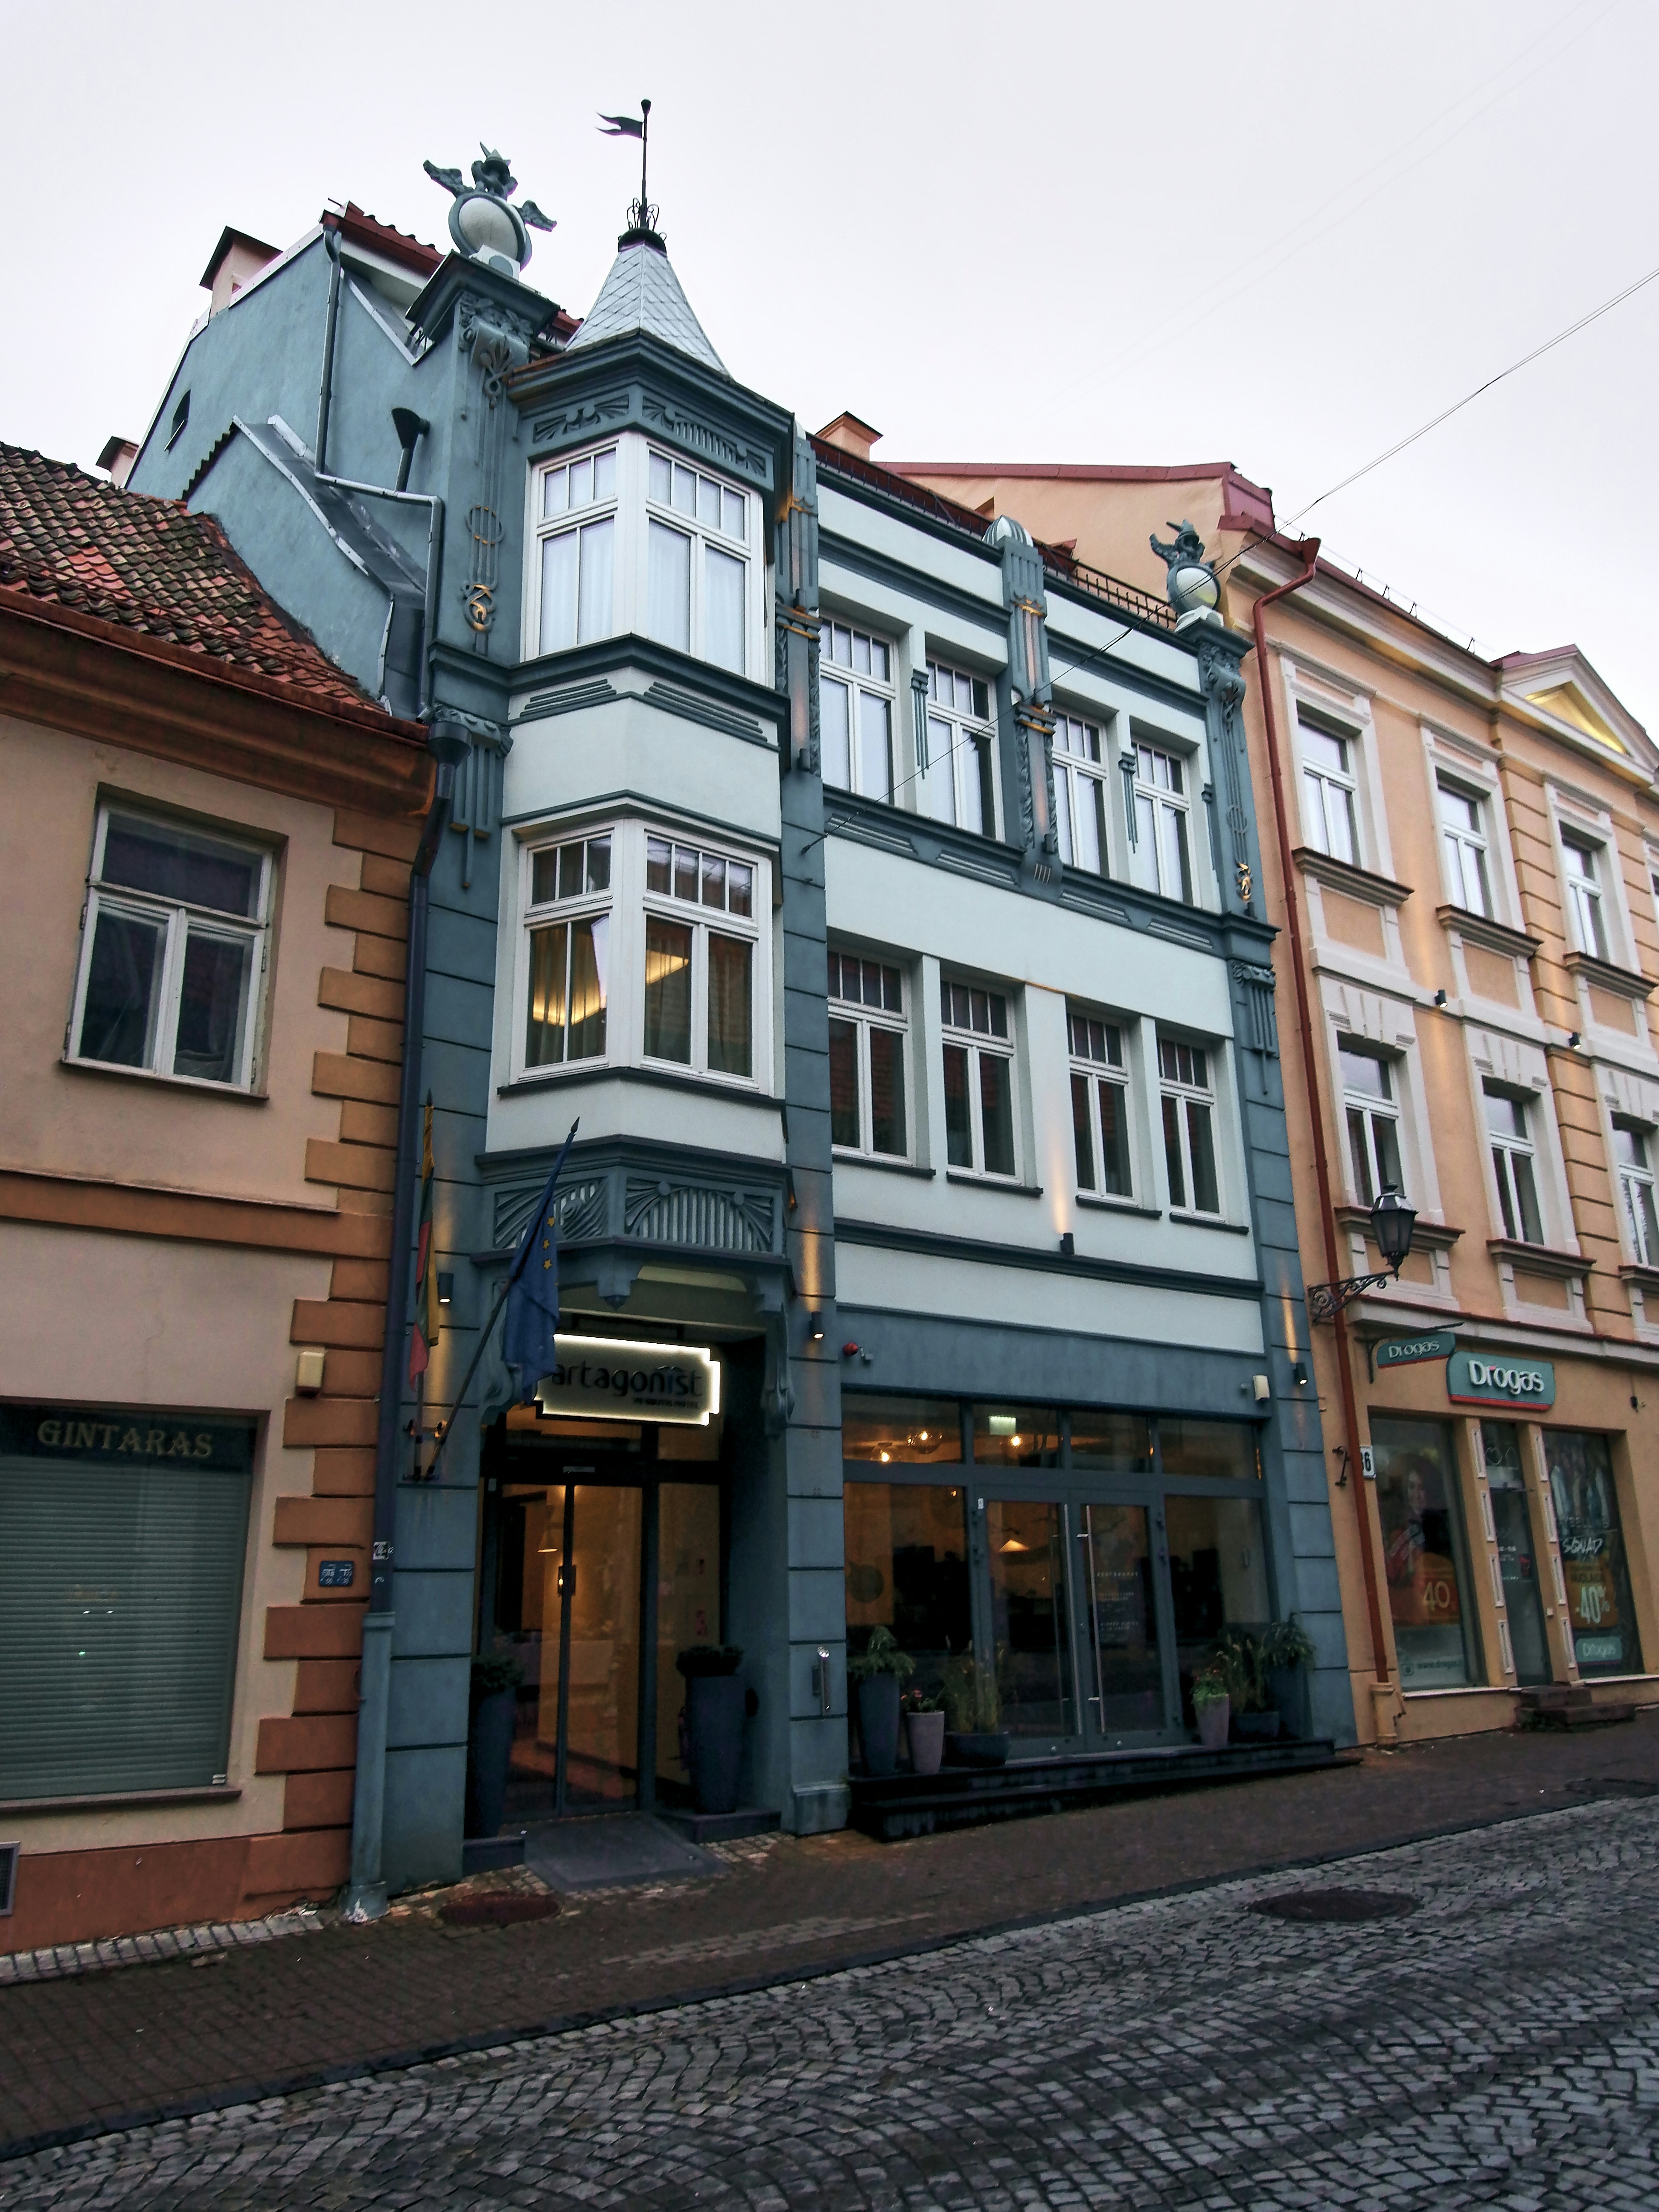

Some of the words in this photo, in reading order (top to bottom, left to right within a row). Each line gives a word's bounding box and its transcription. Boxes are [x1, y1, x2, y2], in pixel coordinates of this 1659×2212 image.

[1388, 1340, 1440, 1359] Drogas
[1468, 1359, 1545, 1395] Drogas
[37, 1420, 212, 1459] GINTARAS
